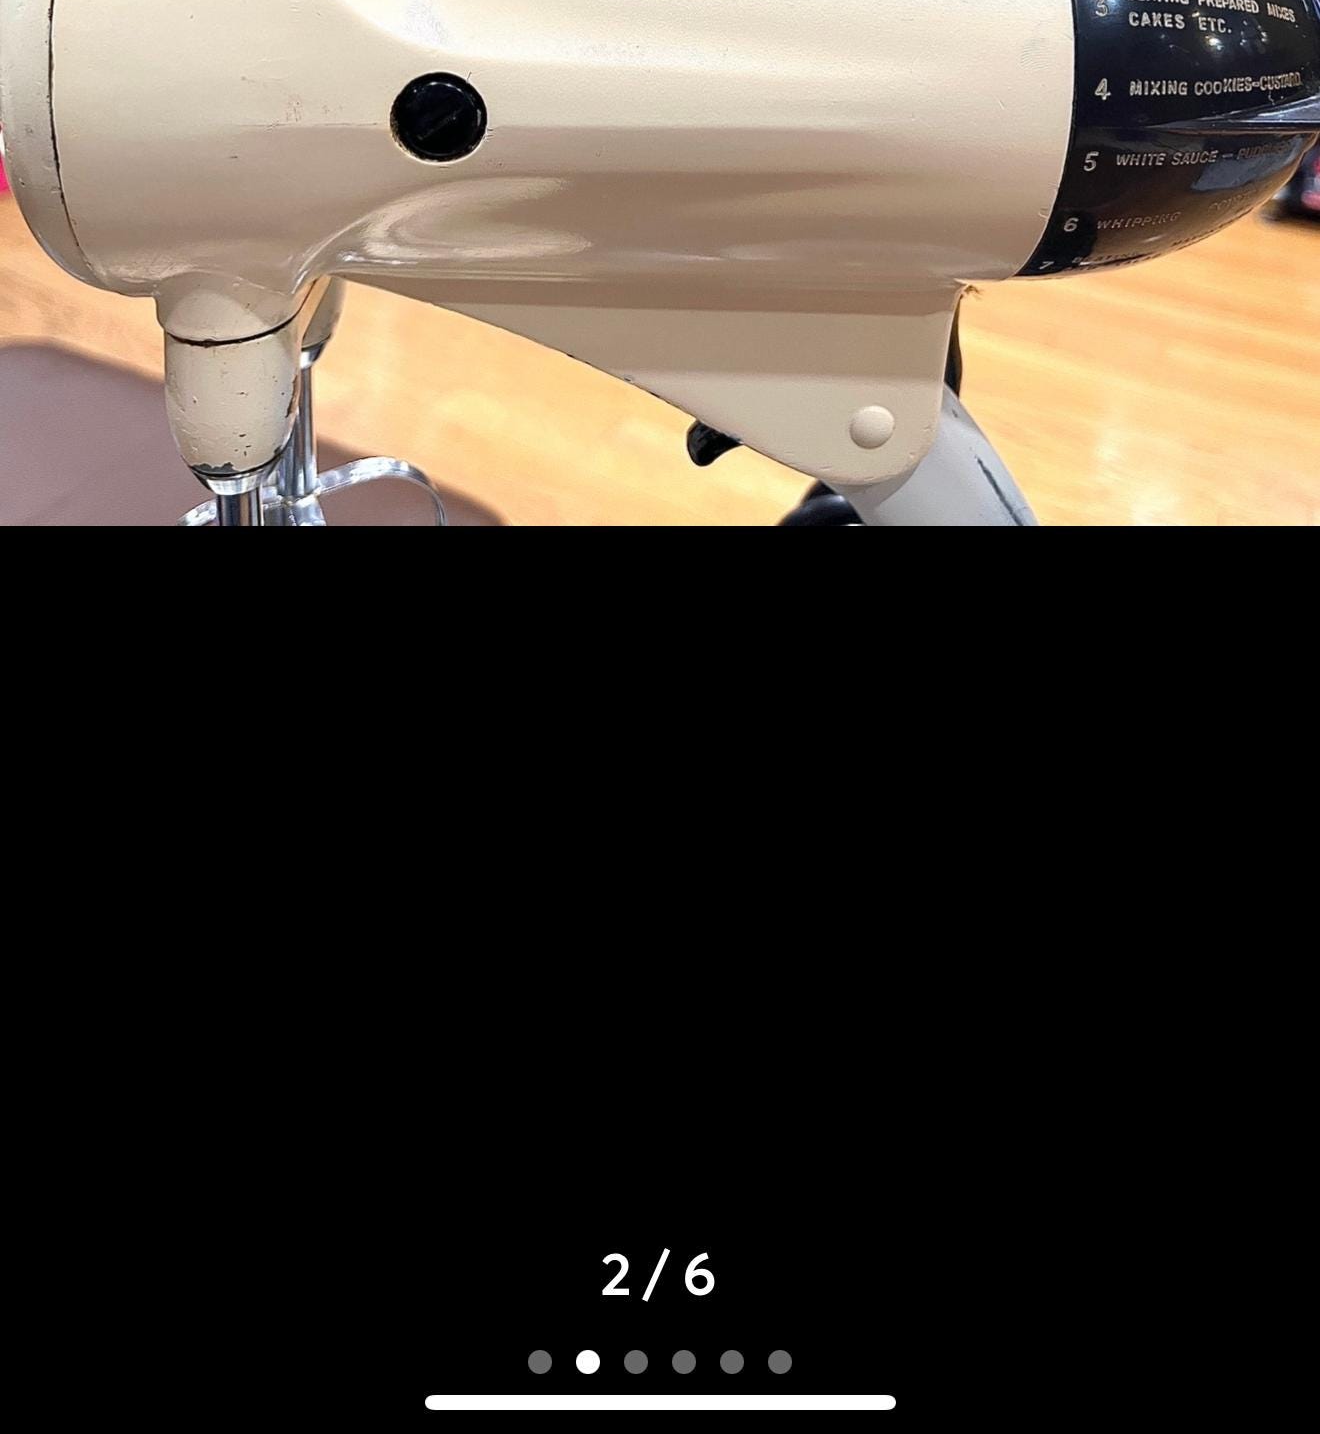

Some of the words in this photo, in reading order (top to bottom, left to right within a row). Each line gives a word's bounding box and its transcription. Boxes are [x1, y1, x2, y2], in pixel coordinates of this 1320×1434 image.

[1129, 11, 1185, 29] CAKES
[1198, 16, 1232, 34] ETC.
[1266, 2, 1297, 23] MIXES
[1094, 78, 1111, 101] 4
[1129, 79, 1188, 97] MIXING
[1083, 151, 1099, 172] 5
[1116, 152, 1165, 167] WHITE
[1171, 150, 1219, 166] SAUCE
[1063, 217, 1079, 233] 6
[1096, 211, 1181, 230] WHIPPING
